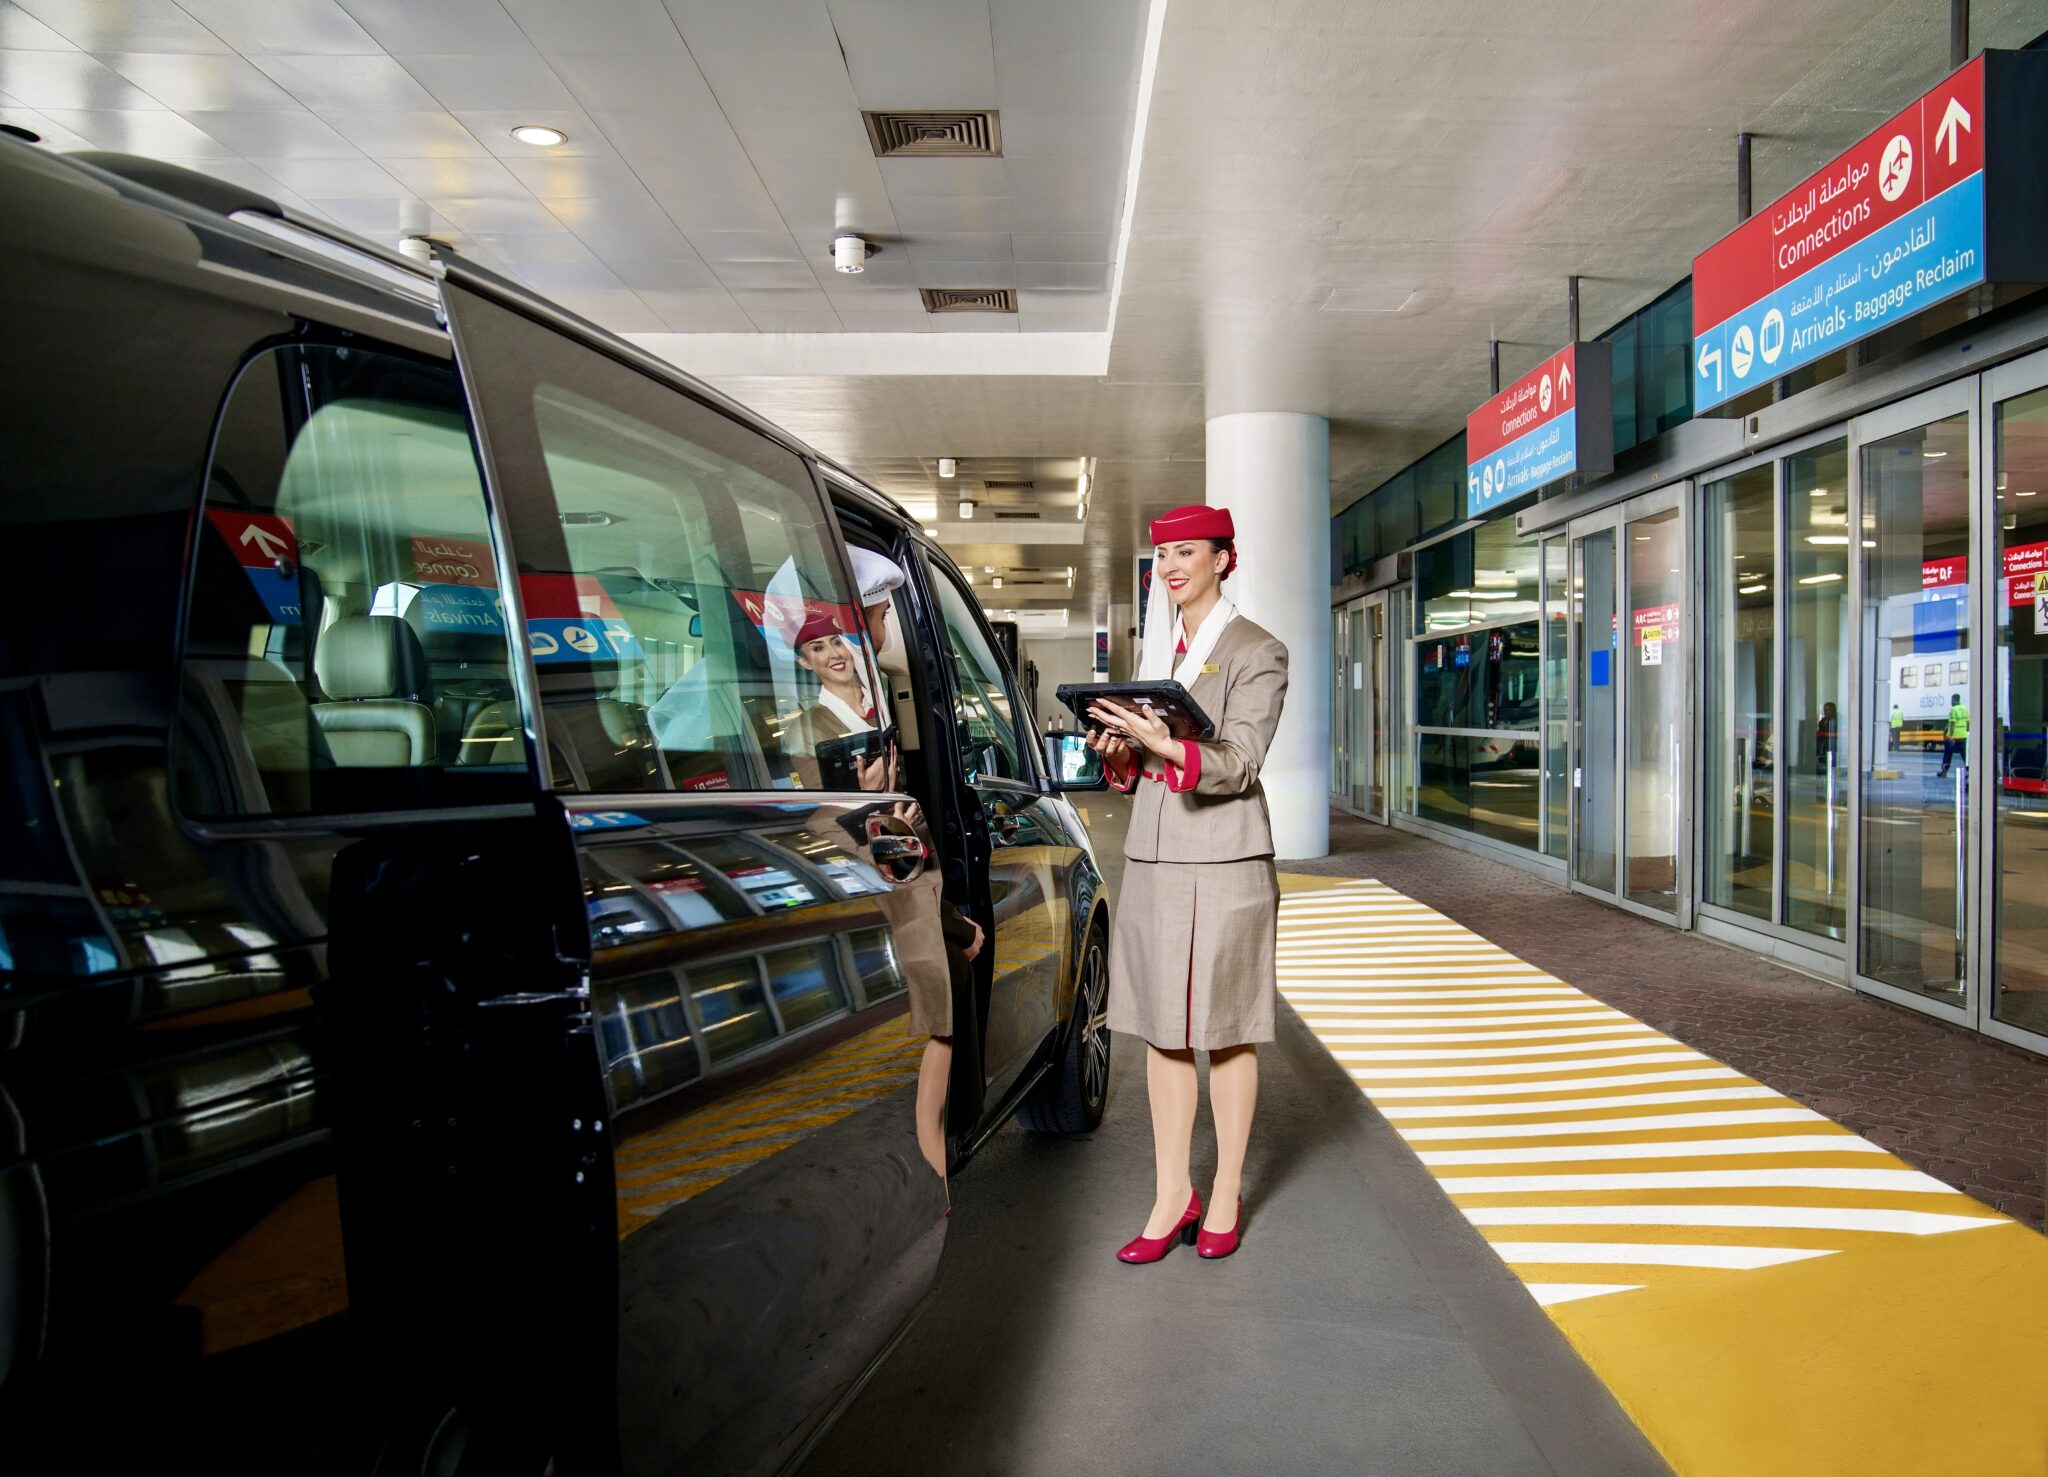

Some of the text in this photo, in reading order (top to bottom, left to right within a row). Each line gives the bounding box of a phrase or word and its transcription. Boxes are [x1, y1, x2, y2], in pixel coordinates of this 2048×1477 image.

[1774, 162, 1870, 236] مواصلة الرحلات
[1778, 197, 1871, 270] Connections
[1871, 216, 1936, 279] القادمون
[1790, 305, 1846, 354] Arrivals
[1855, 280, 1913, 322] Baggage
[1916, 248, 1975, 292] Reclaim
[1825, 263, 1861, 306] استلام
[1502, 405, 1538, 436] Connections
[1507, 465, 1529, 488] Arrivals
[1531, 461, 1552, 479] Baggage
[1552, 449, 1573, 468] Reclaim
[2009, 560, 2043, 572] Connections
